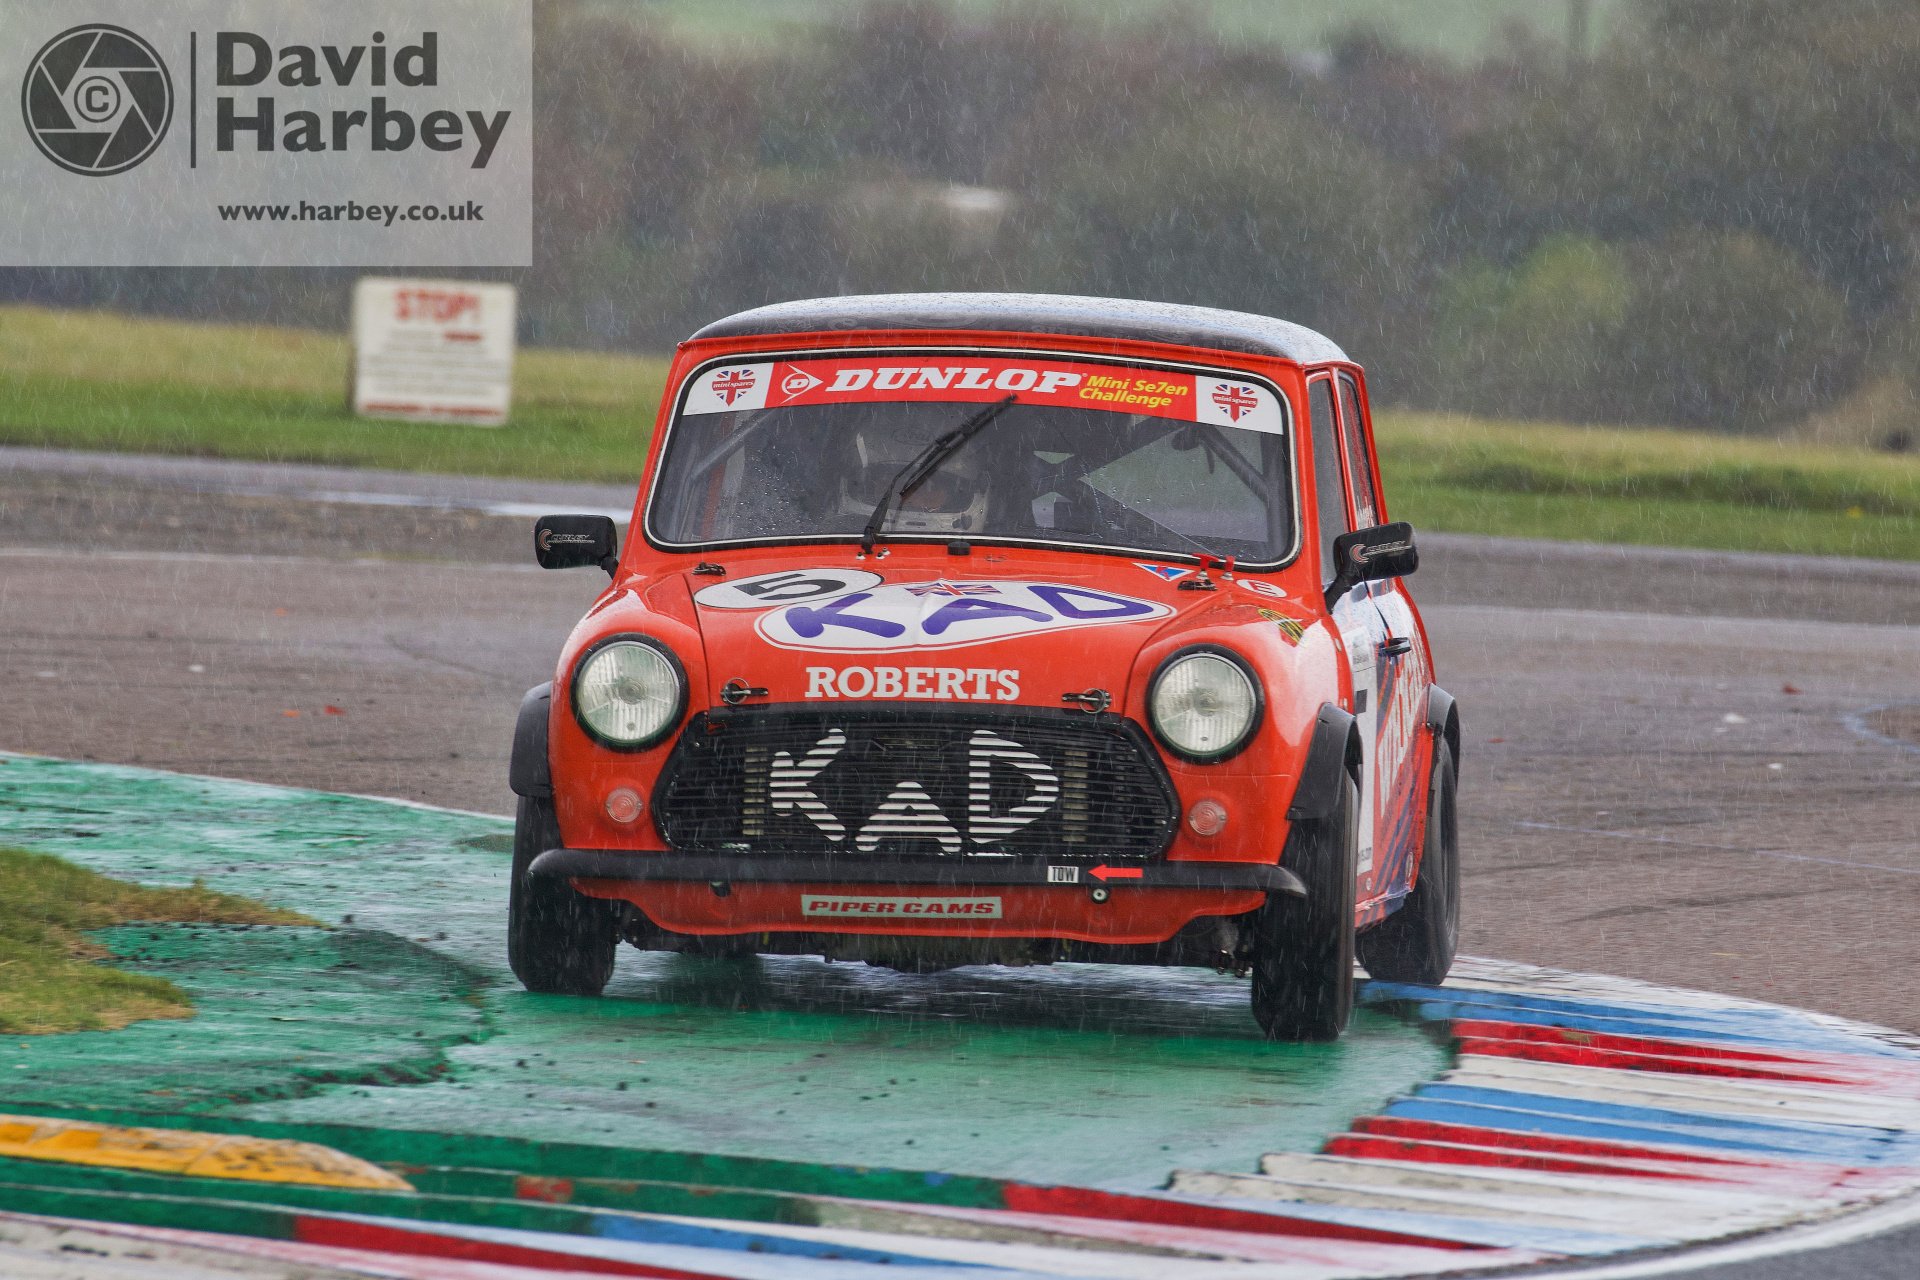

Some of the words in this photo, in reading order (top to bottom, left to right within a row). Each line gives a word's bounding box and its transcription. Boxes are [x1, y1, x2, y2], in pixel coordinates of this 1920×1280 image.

[825, 367, 1082, 393] DUNLOP
[1086, 375, 1131, 390] Mini
[1132, 379, 1188, 396] Se7en
[1079, 387, 1172, 408] Challenge
[733, 573, 847, 600] 5
[785, 584, 1154, 639] KAD
[804, 666, 1021, 701] ROBERTS
[769, 728, 1060, 853] KAD
[1052, 867, 1076, 882] TOW
[809, 901, 897, 913] PIPER
[902, 902, 994, 915] CAMS
